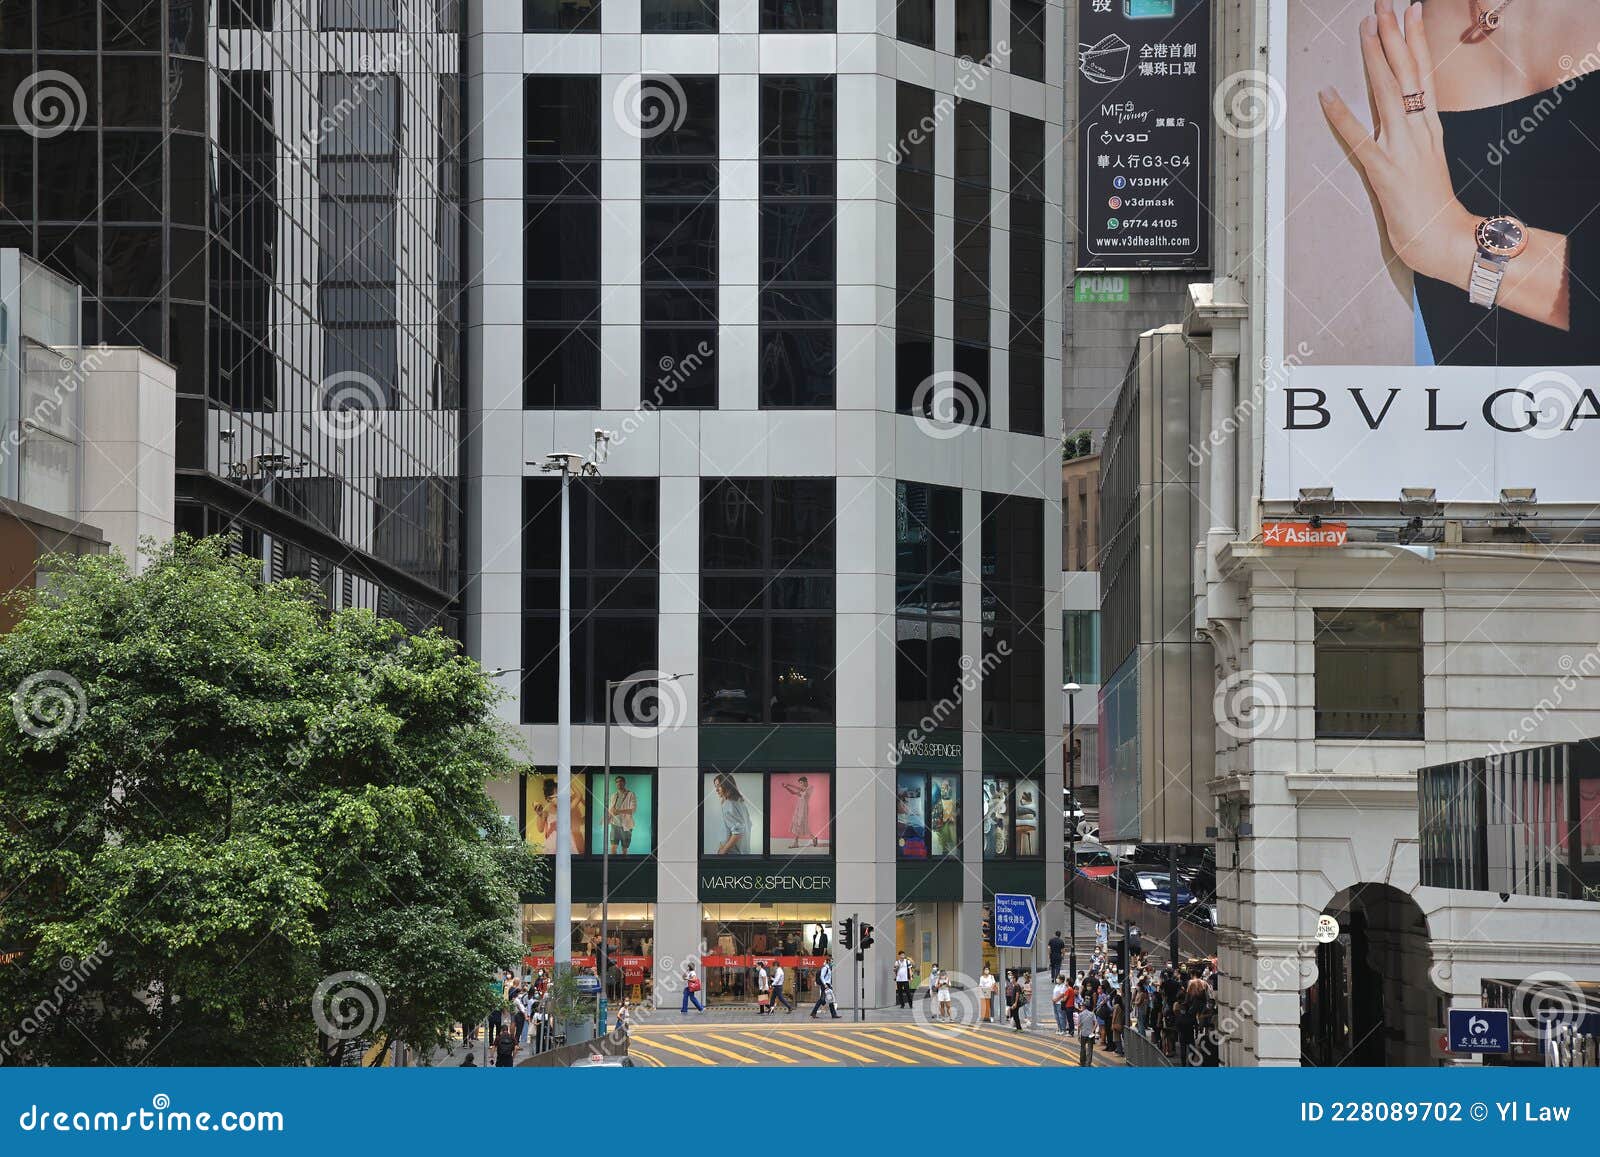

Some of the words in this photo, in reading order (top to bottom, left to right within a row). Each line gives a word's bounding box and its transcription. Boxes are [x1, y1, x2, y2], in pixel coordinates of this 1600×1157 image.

[1139, 43, 1197, 58] 全港首創
[1139, 61, 1197, 76] 爆珠口罩
[1130, 178, 1169, 186] V3DHK
[1125, 198, 1175, 206] v3dmask
[1122, 220, 1148, 228] 6774
[1152, 220, 1178, 228] 4105
[1096, 236, 1190, 246] www.v3dhealth.com
[1285, 527, 1346, 546] Asiaray
[702, 876, 753, 889] MARKS
[765, 876, 831, 889] SPENCER
